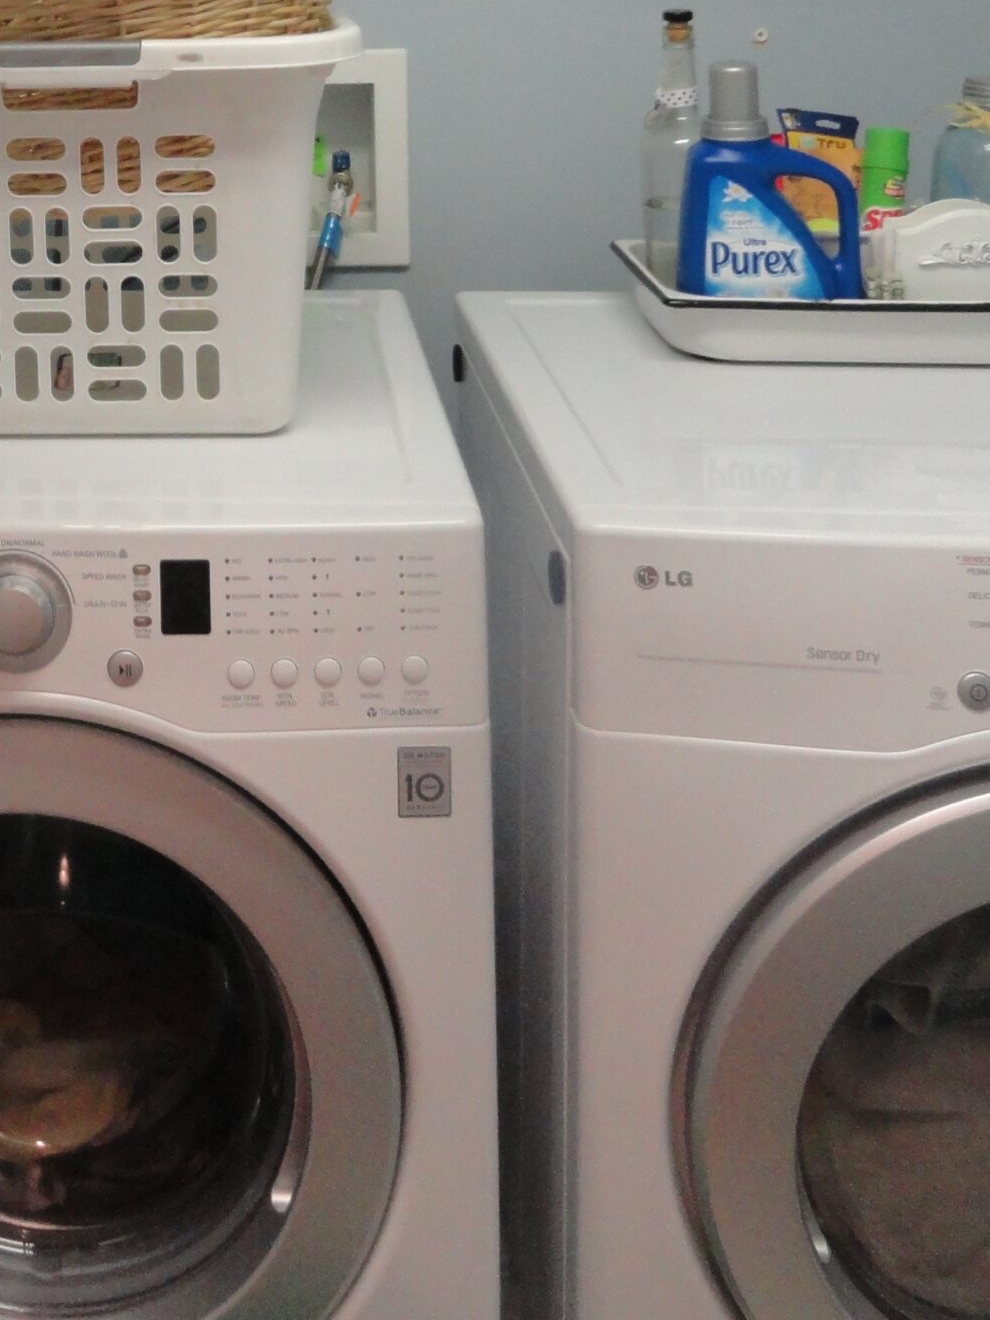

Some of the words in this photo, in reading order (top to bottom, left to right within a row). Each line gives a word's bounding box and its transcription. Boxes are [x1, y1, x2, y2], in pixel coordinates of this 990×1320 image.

[743, 236, 768, 247] Ultra
[710, 241, 798, 276] Purex
[664, 569, 693, 588] LG
[805, 645, 852, 662] Sensor
[855, 648, 881, 666] Dry
